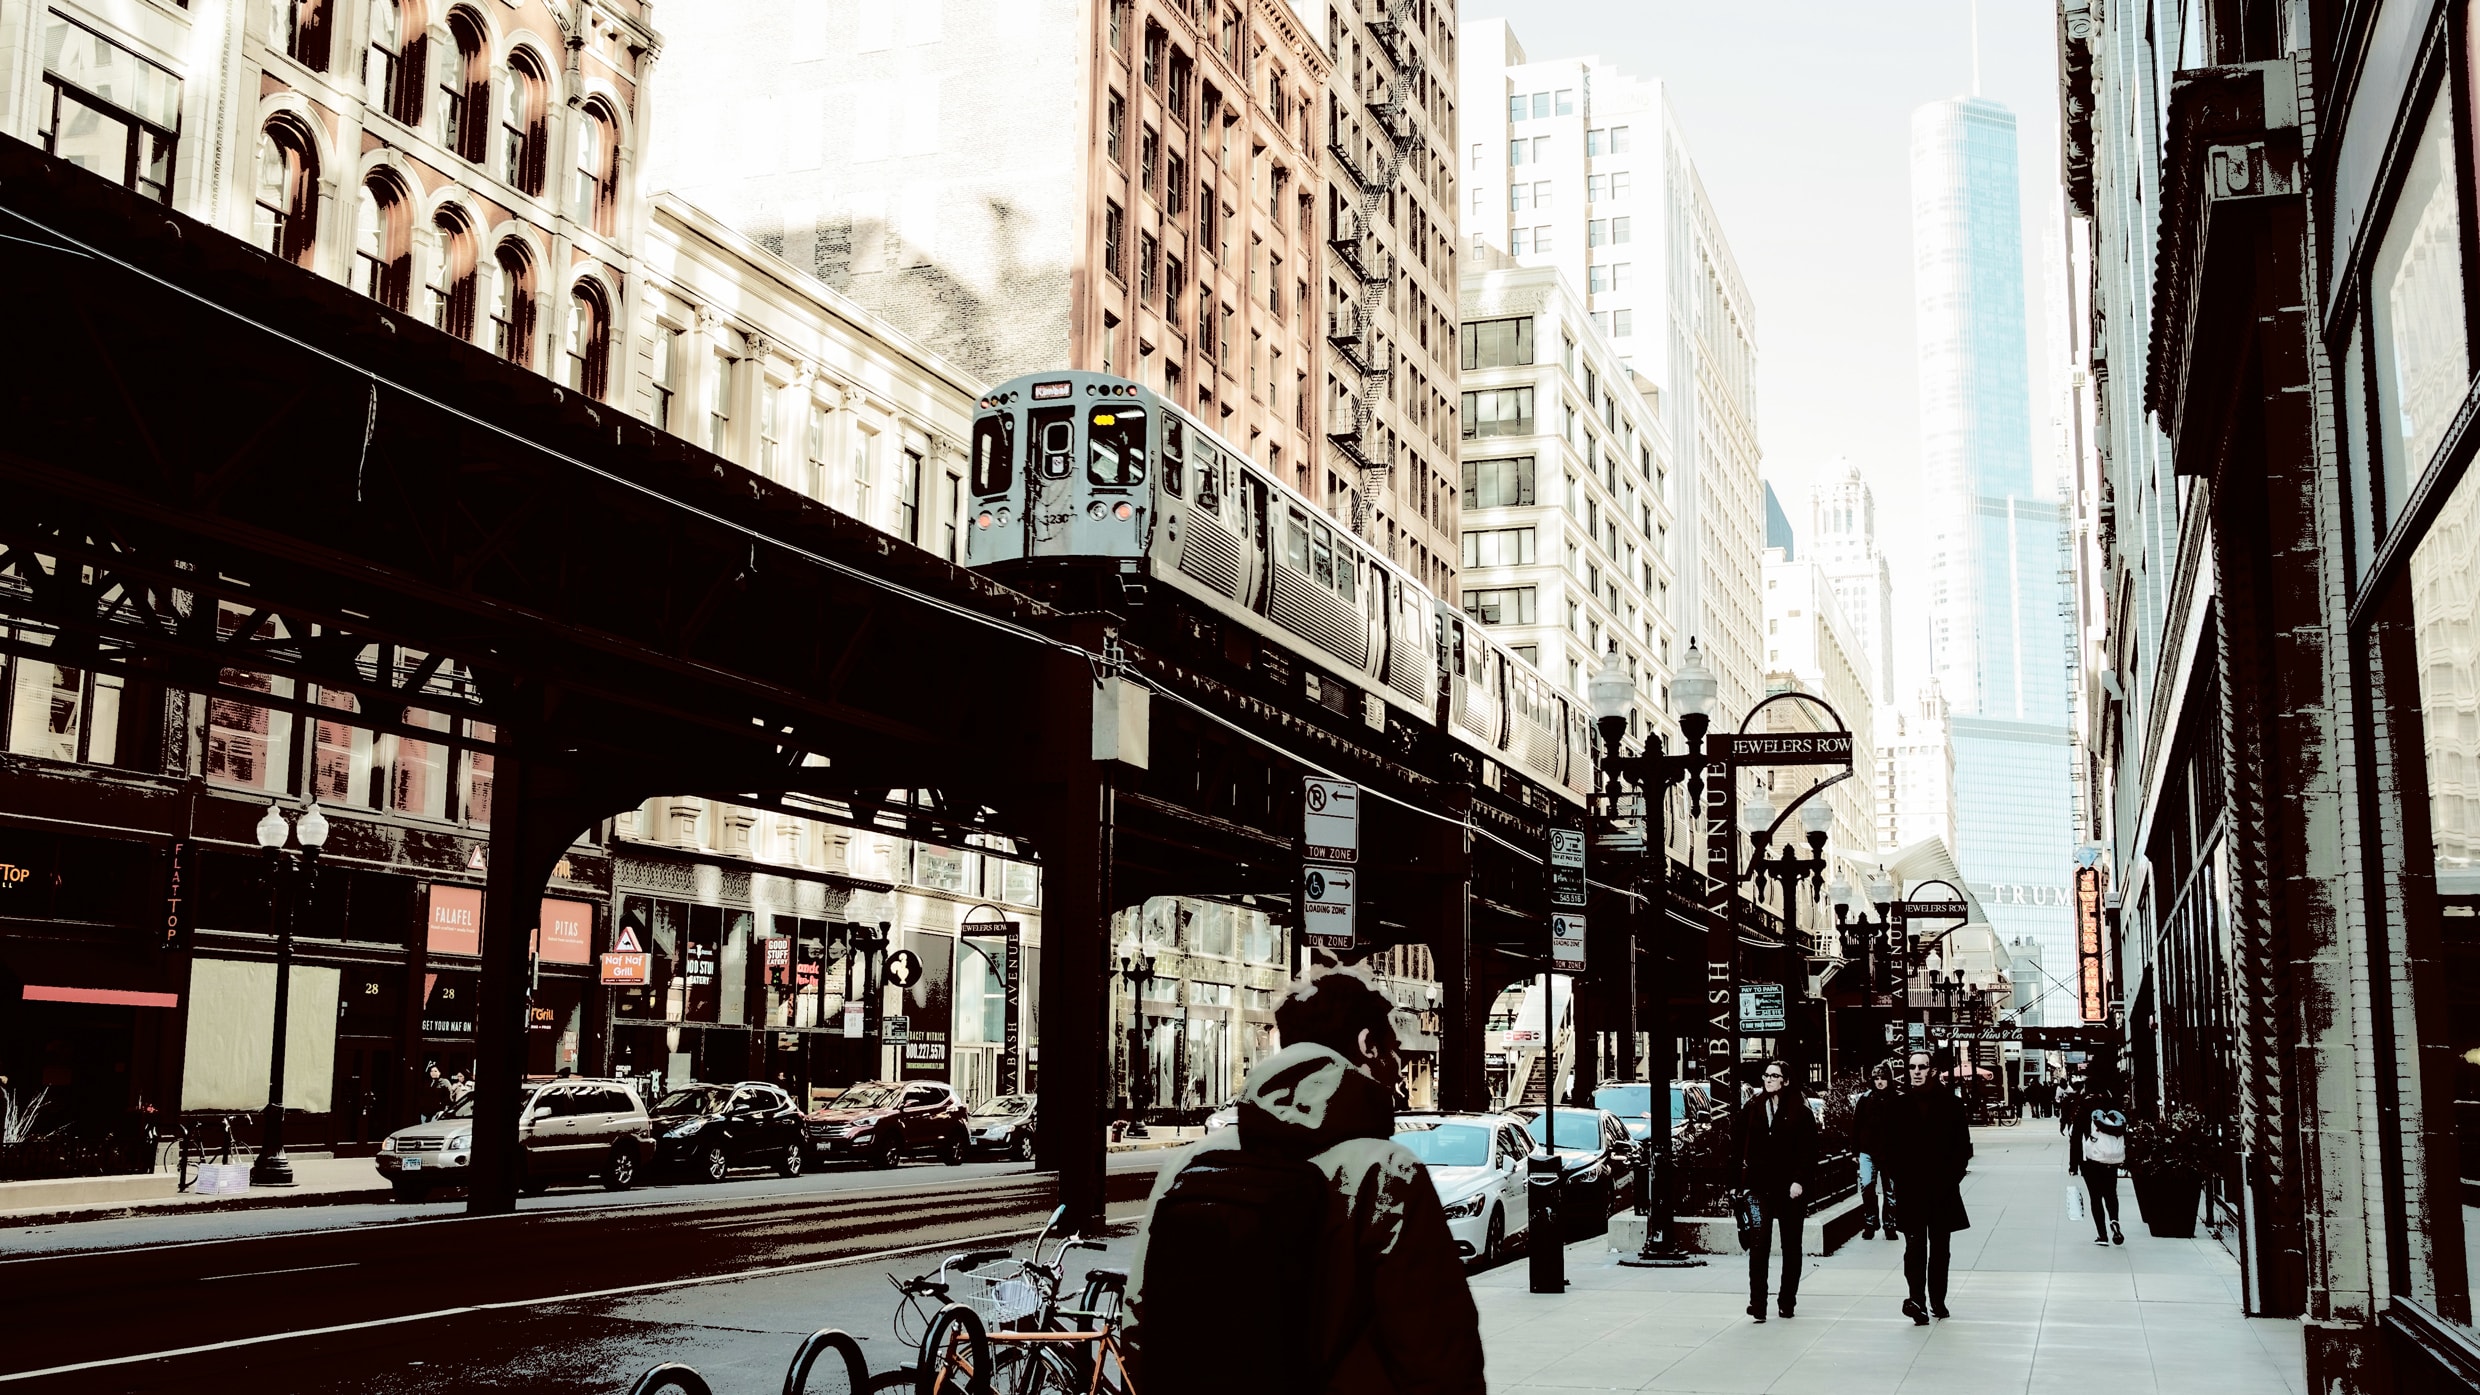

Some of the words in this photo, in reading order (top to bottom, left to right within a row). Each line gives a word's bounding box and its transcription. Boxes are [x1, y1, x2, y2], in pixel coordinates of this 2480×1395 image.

[1732, 739, 1812, 754] JEWELERS
[1817, 738, 1852, 752] ROW
[1706, 761, 1729, 921] AVENUE
[1309, 846, 1326, 857] TOW
[1330, 848, 1352, 860] ZONE
[1990, 884, 2074, 907] TRUM
[1306, 903, 1331, 914] LOADING
[1332, 906, 1347, 916] ZONE
[1905, 904, 1947, 913] JEWELERS
[1948, 904, 1968, 912] ROW
[167, 899, 182, 941] TOP
[435, 906, 472, 926] FALAFEL
[555, 920, 579, 937] PITAS
[962, 924, 993, 932] EWELERS
[768, 940, 788, 949] GOOD
[1308, 934, 1325, 946] TOW
[1328, 936, 1348, 947] ZONE
[605, 956, 623, 966] Naf
[625, 956, 643, 966] Naf
[767, 950, 788, 959] STUFF
[1890, 915, 1904, 998] AVENUE
[613, 967, 633, 976] Grill
[1008, 933, 1019, 1006] AVENUE
[365, 982, 379, 995] 28
[442, 988, 455, 999] 28
[422, 1020, 434, 1030] GET
[434, 1020, 450, 1031] YOUR
[450, 1021, 463, 1031] NAF
[463, 1021, 472, 1032] ON
[1708, 960, 1731, 1121] WABASH
[1006, 1021, 1018, 1096] WABASH
